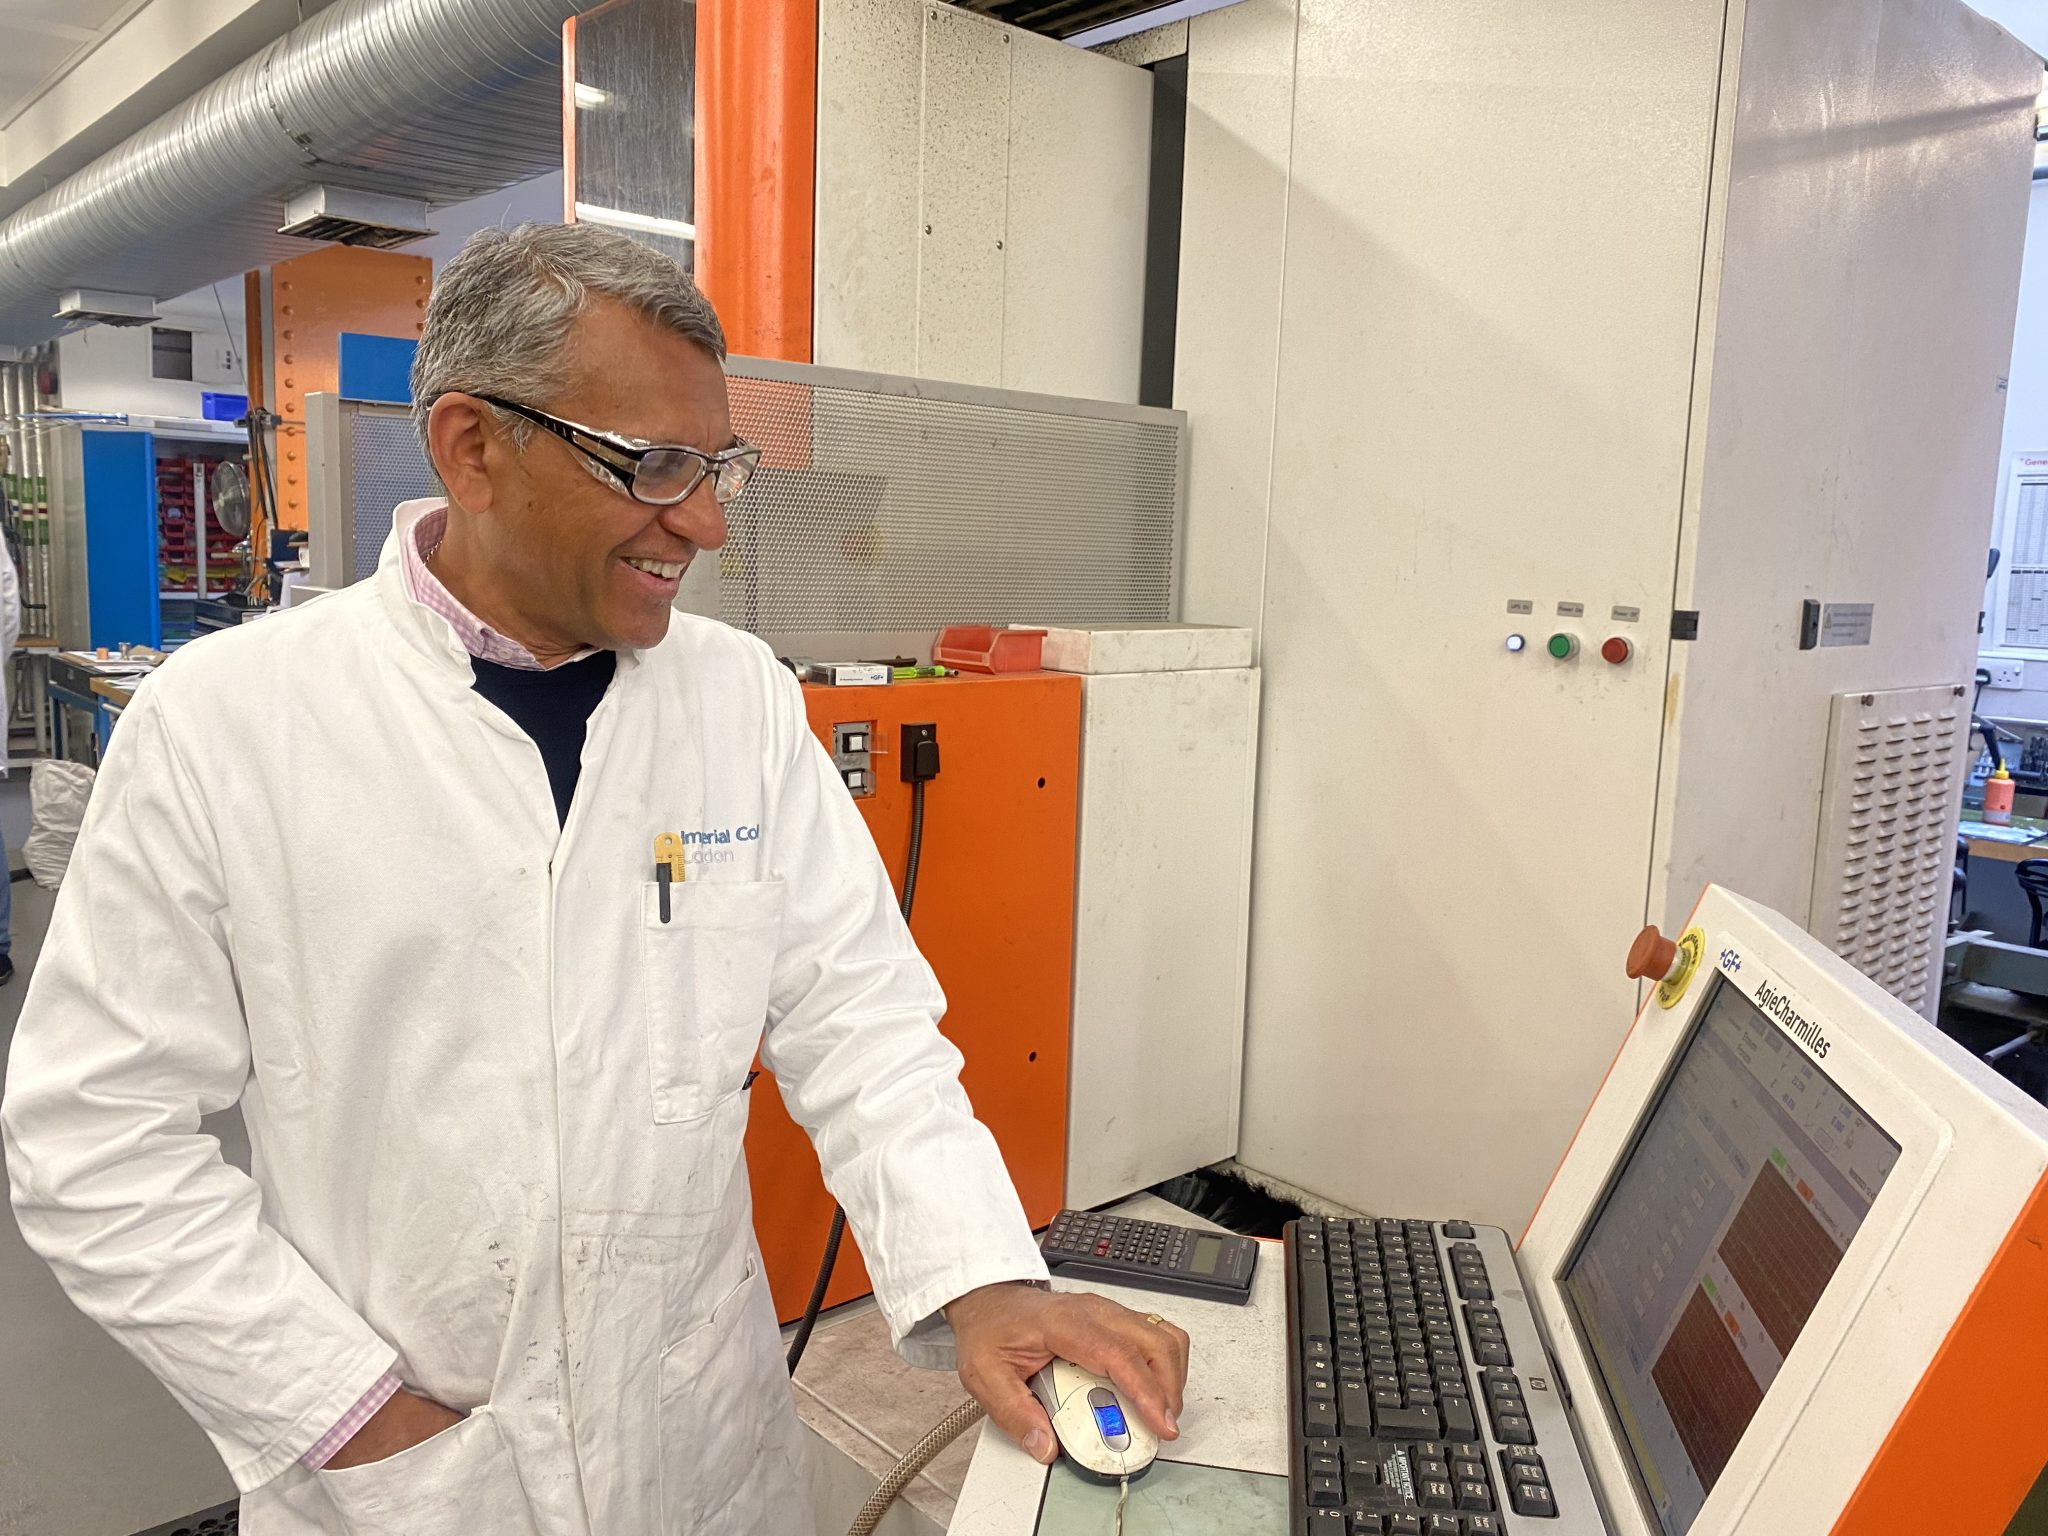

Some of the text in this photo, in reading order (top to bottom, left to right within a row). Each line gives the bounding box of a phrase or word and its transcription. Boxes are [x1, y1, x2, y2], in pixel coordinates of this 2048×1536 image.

[681, 829, 731, 848] Imerial
[1754, 979, 1831, 1059] AgieCharmilles
[1398, 1456, 1414, 1500] IMPORTANT NOTICE
